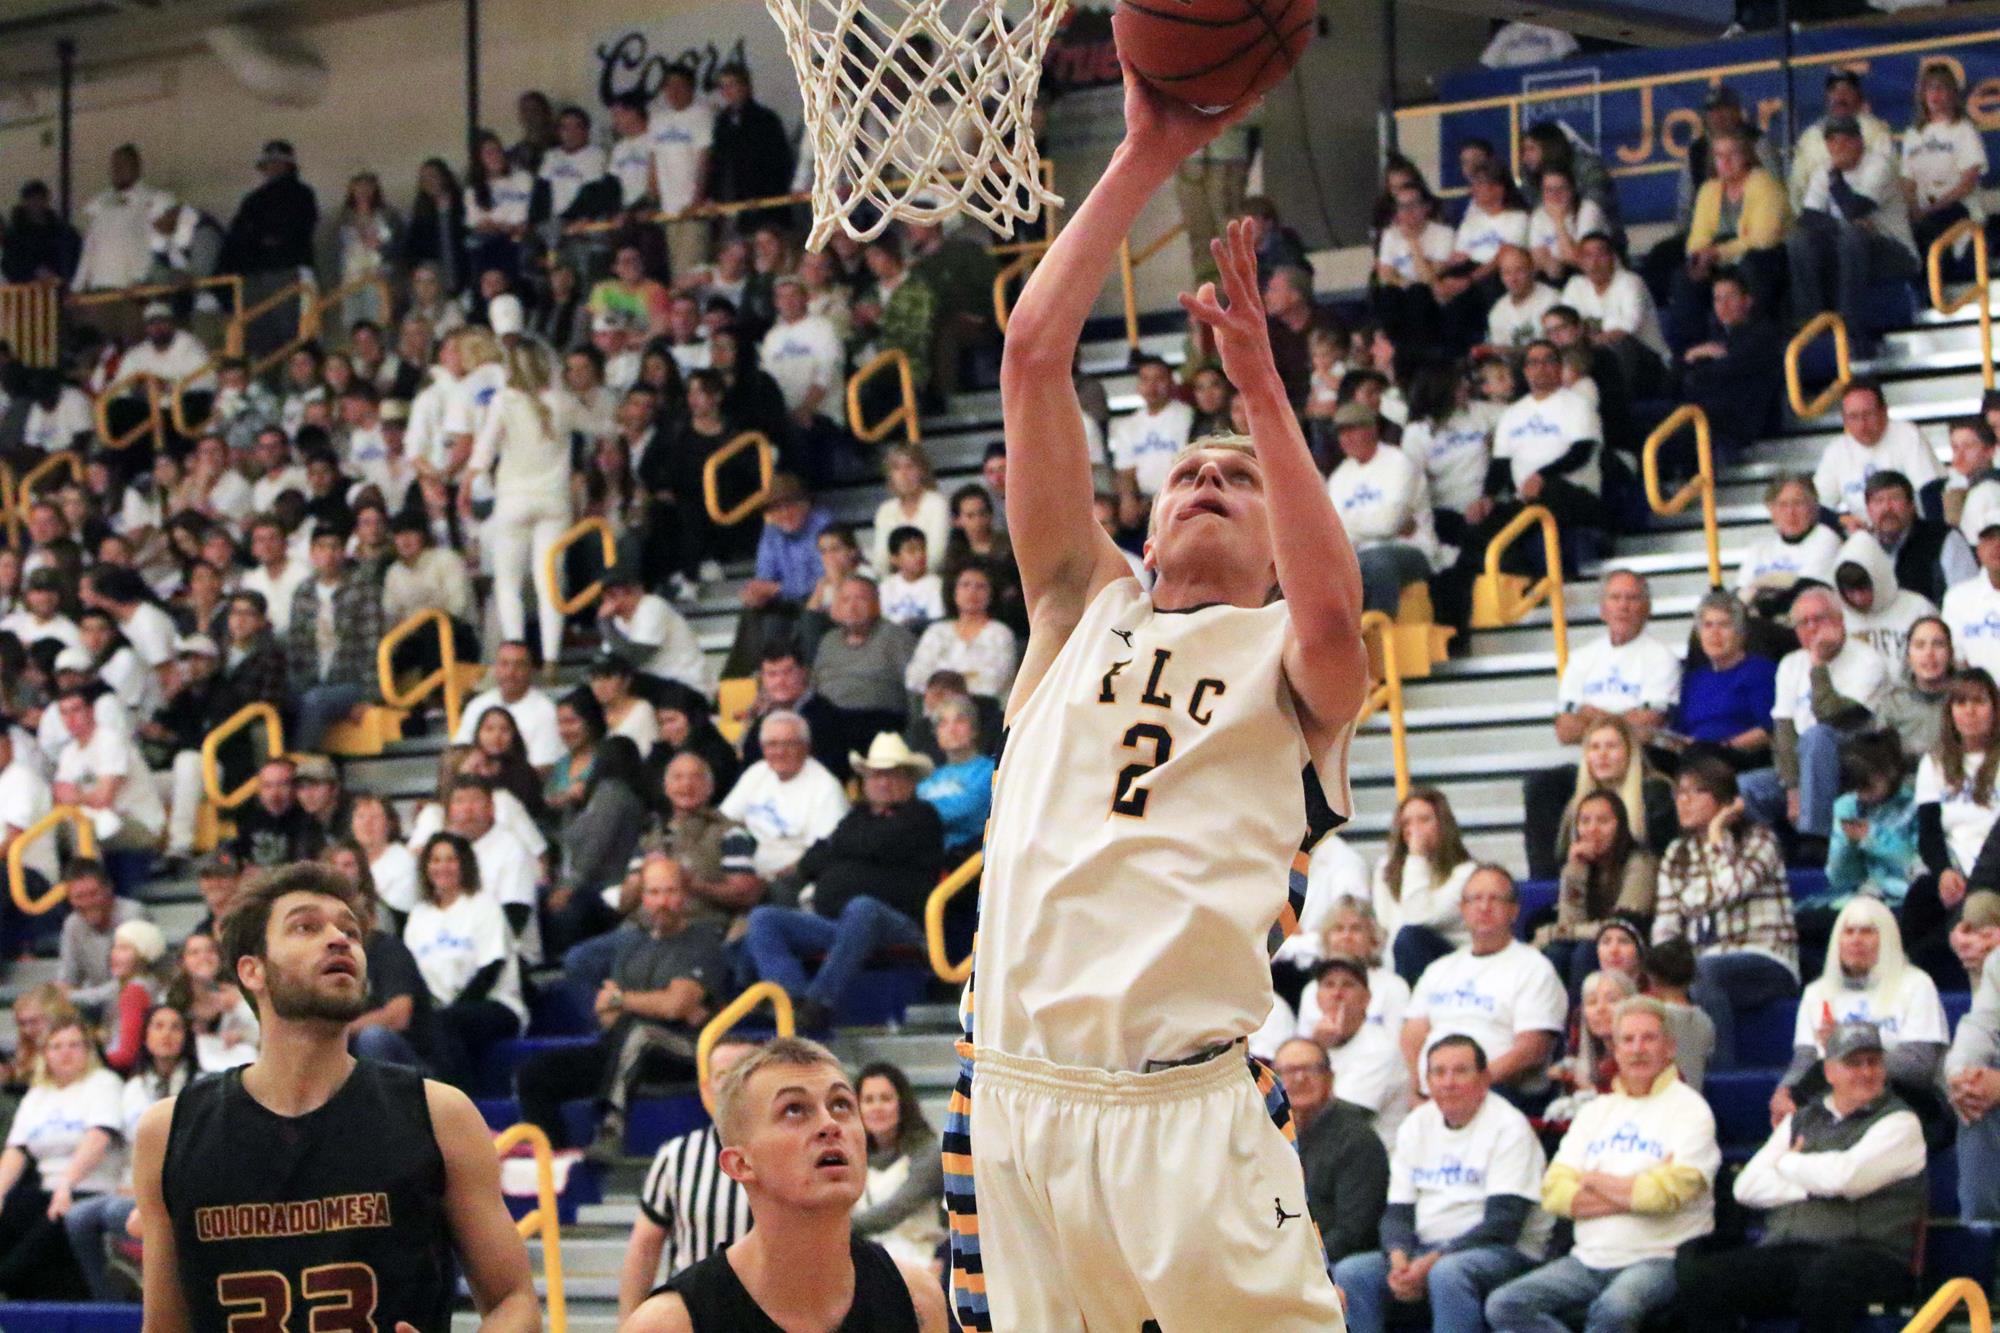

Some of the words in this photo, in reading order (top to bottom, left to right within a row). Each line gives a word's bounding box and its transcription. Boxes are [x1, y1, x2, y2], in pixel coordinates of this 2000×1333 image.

[1109, 721, 1174, 819] 2
[196, 1200, 322, 1241] COLORADO
[323, 1192, 391, 1230] MESA
[217, 1263, 378, 1333] 33
